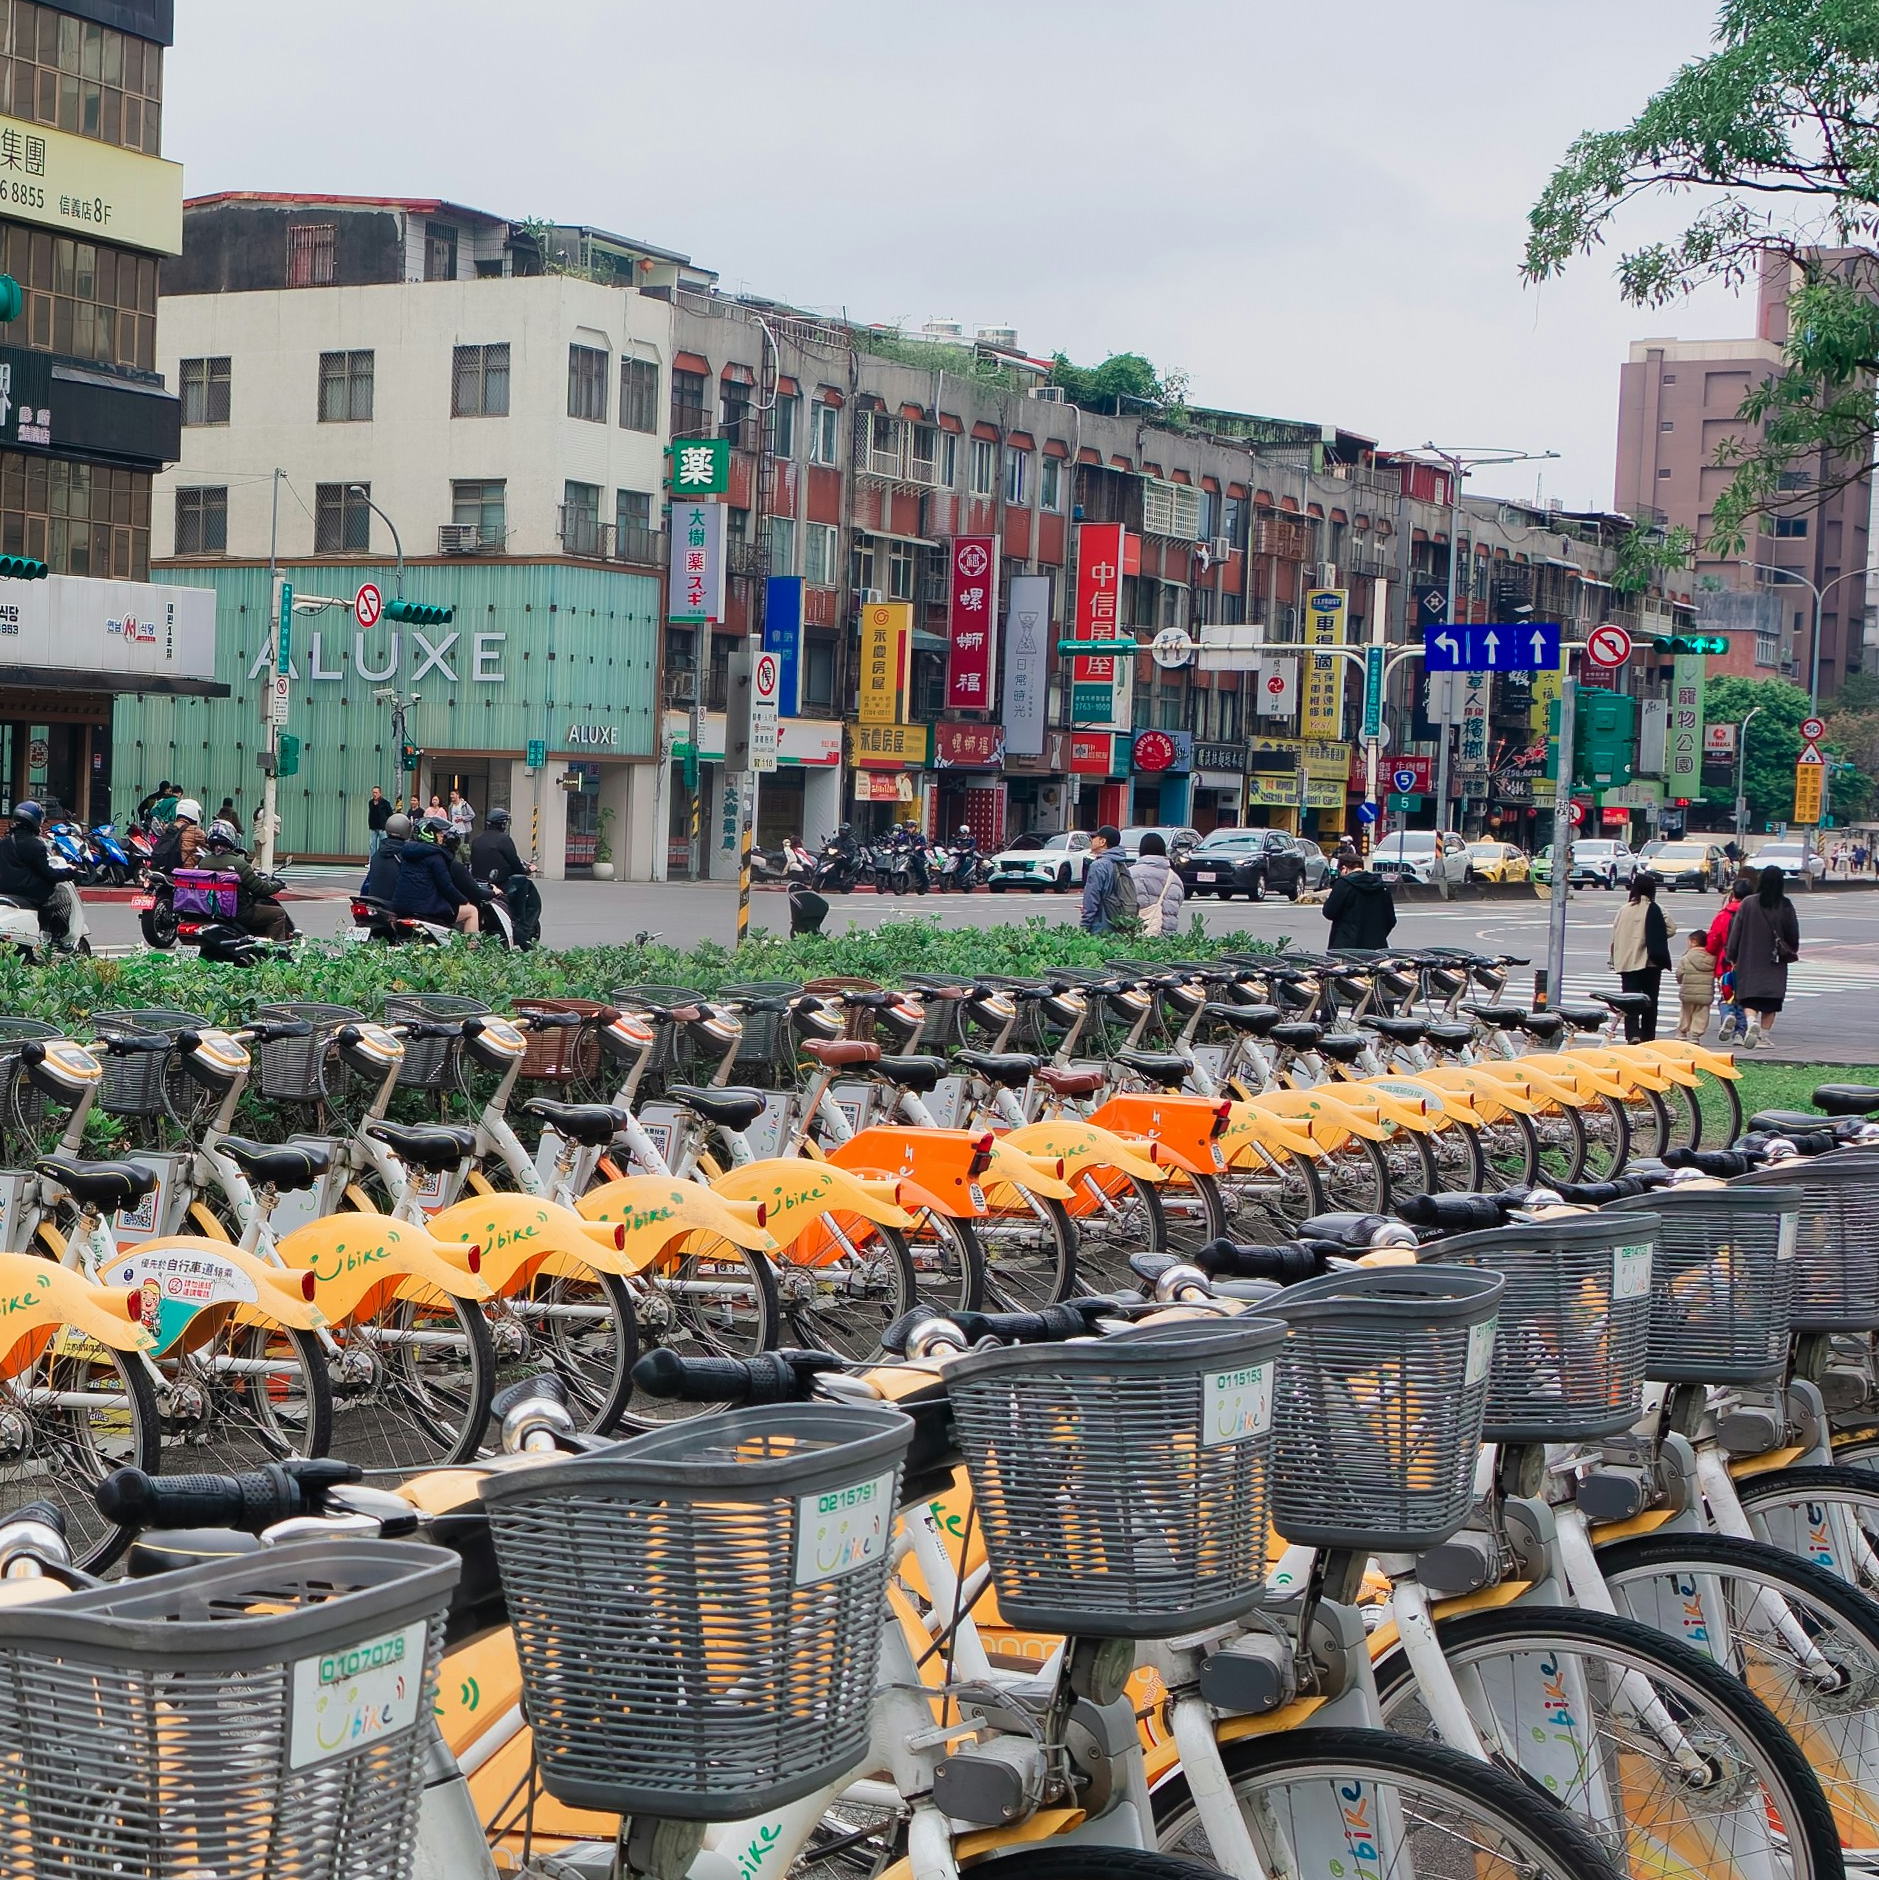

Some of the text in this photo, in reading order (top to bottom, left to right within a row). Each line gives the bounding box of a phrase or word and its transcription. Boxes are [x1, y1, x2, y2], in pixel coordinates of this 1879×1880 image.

[11, 182, 44, 209] 8855
[59, 194, 112, 225] 信義店8F
[680, 446, 715, 485] 薬
[247, 631, 507, 683] ALUXE
[871, 629, 887, 690] 永慶房屋
[568, 725, 618, 745] ALUXE
[860, 727, 905, 753] 永慶房屋
[1806, 725, 1819, 734] 50
[1399, 775, 1410, 789] 5
[1400, 797, 1410, 808] 5
[1217, 1367, 1263, 1390] 0115153
[819, 1482, 879, 1515] 0215791
[320, 1637, 406, 1684] 0107079
